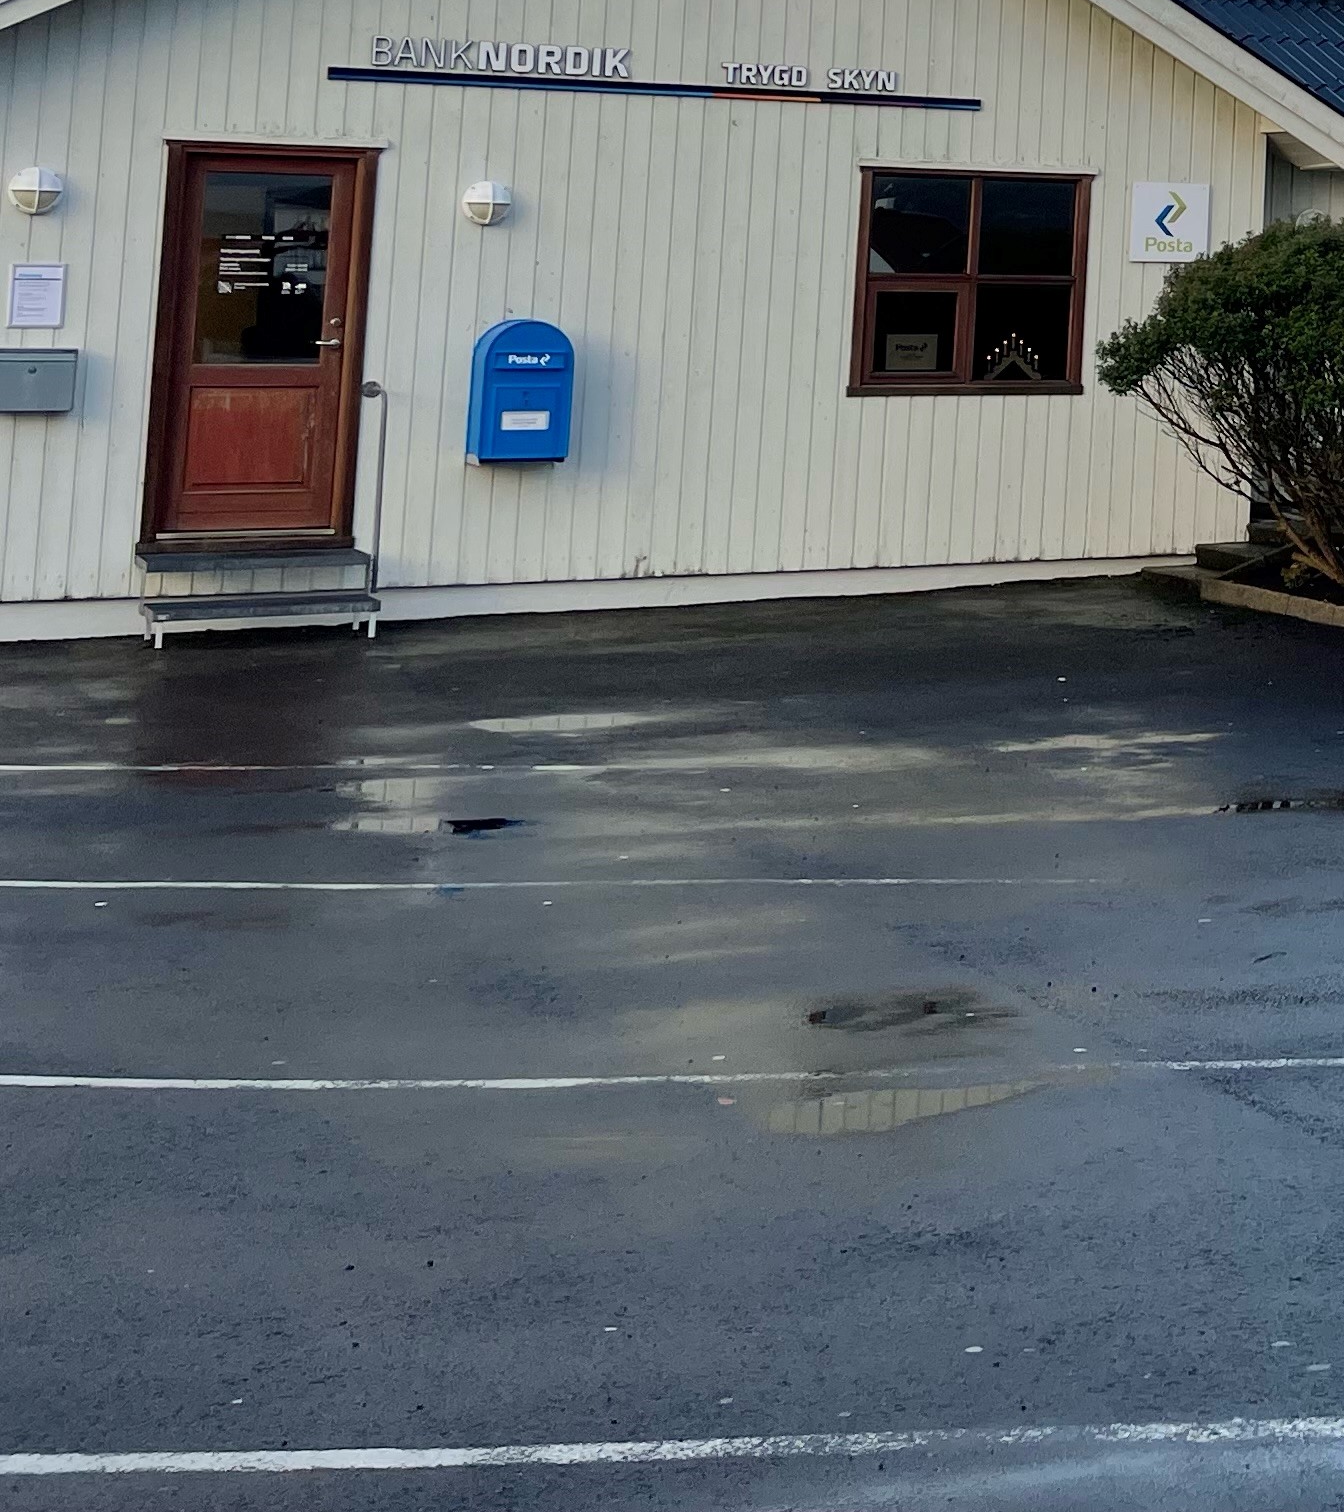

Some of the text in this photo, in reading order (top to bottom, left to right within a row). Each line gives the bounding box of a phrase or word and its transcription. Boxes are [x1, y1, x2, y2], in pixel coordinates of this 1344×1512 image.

[371, 35, 630, 78] BANKNORDIK
[722, 62, 897, 91] TRYGD SKYN
[1144, 236, 1193, 253] Posta
[508, 354, 539, 364] Posta
